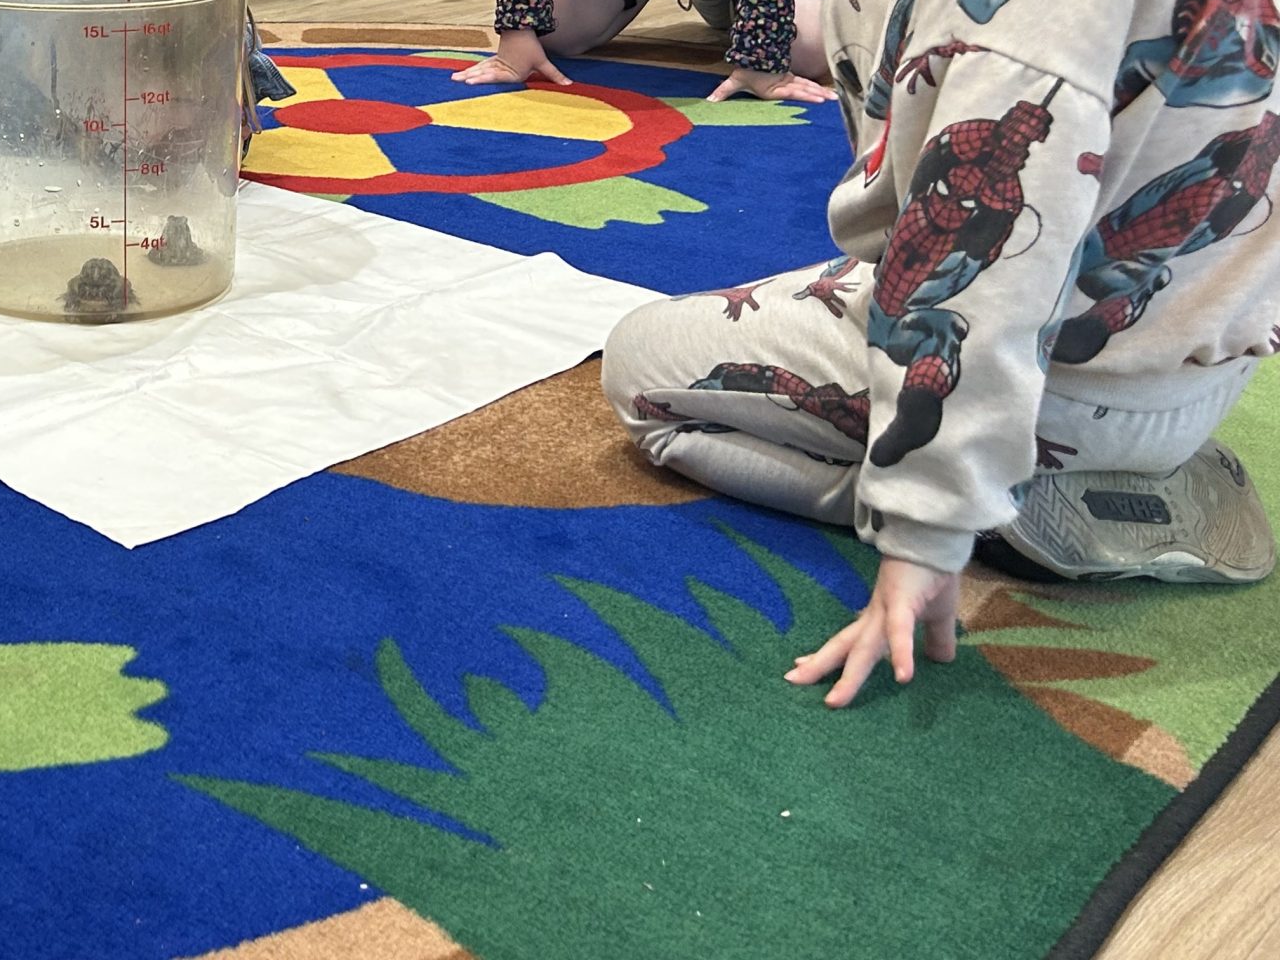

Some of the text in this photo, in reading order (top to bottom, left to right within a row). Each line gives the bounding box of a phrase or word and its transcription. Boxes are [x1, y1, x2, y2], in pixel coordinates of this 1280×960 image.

[83, 25, 110, 39] 15L
[83, 120, 110, 133] 10L
[89, 215, 110, 229] 5L
